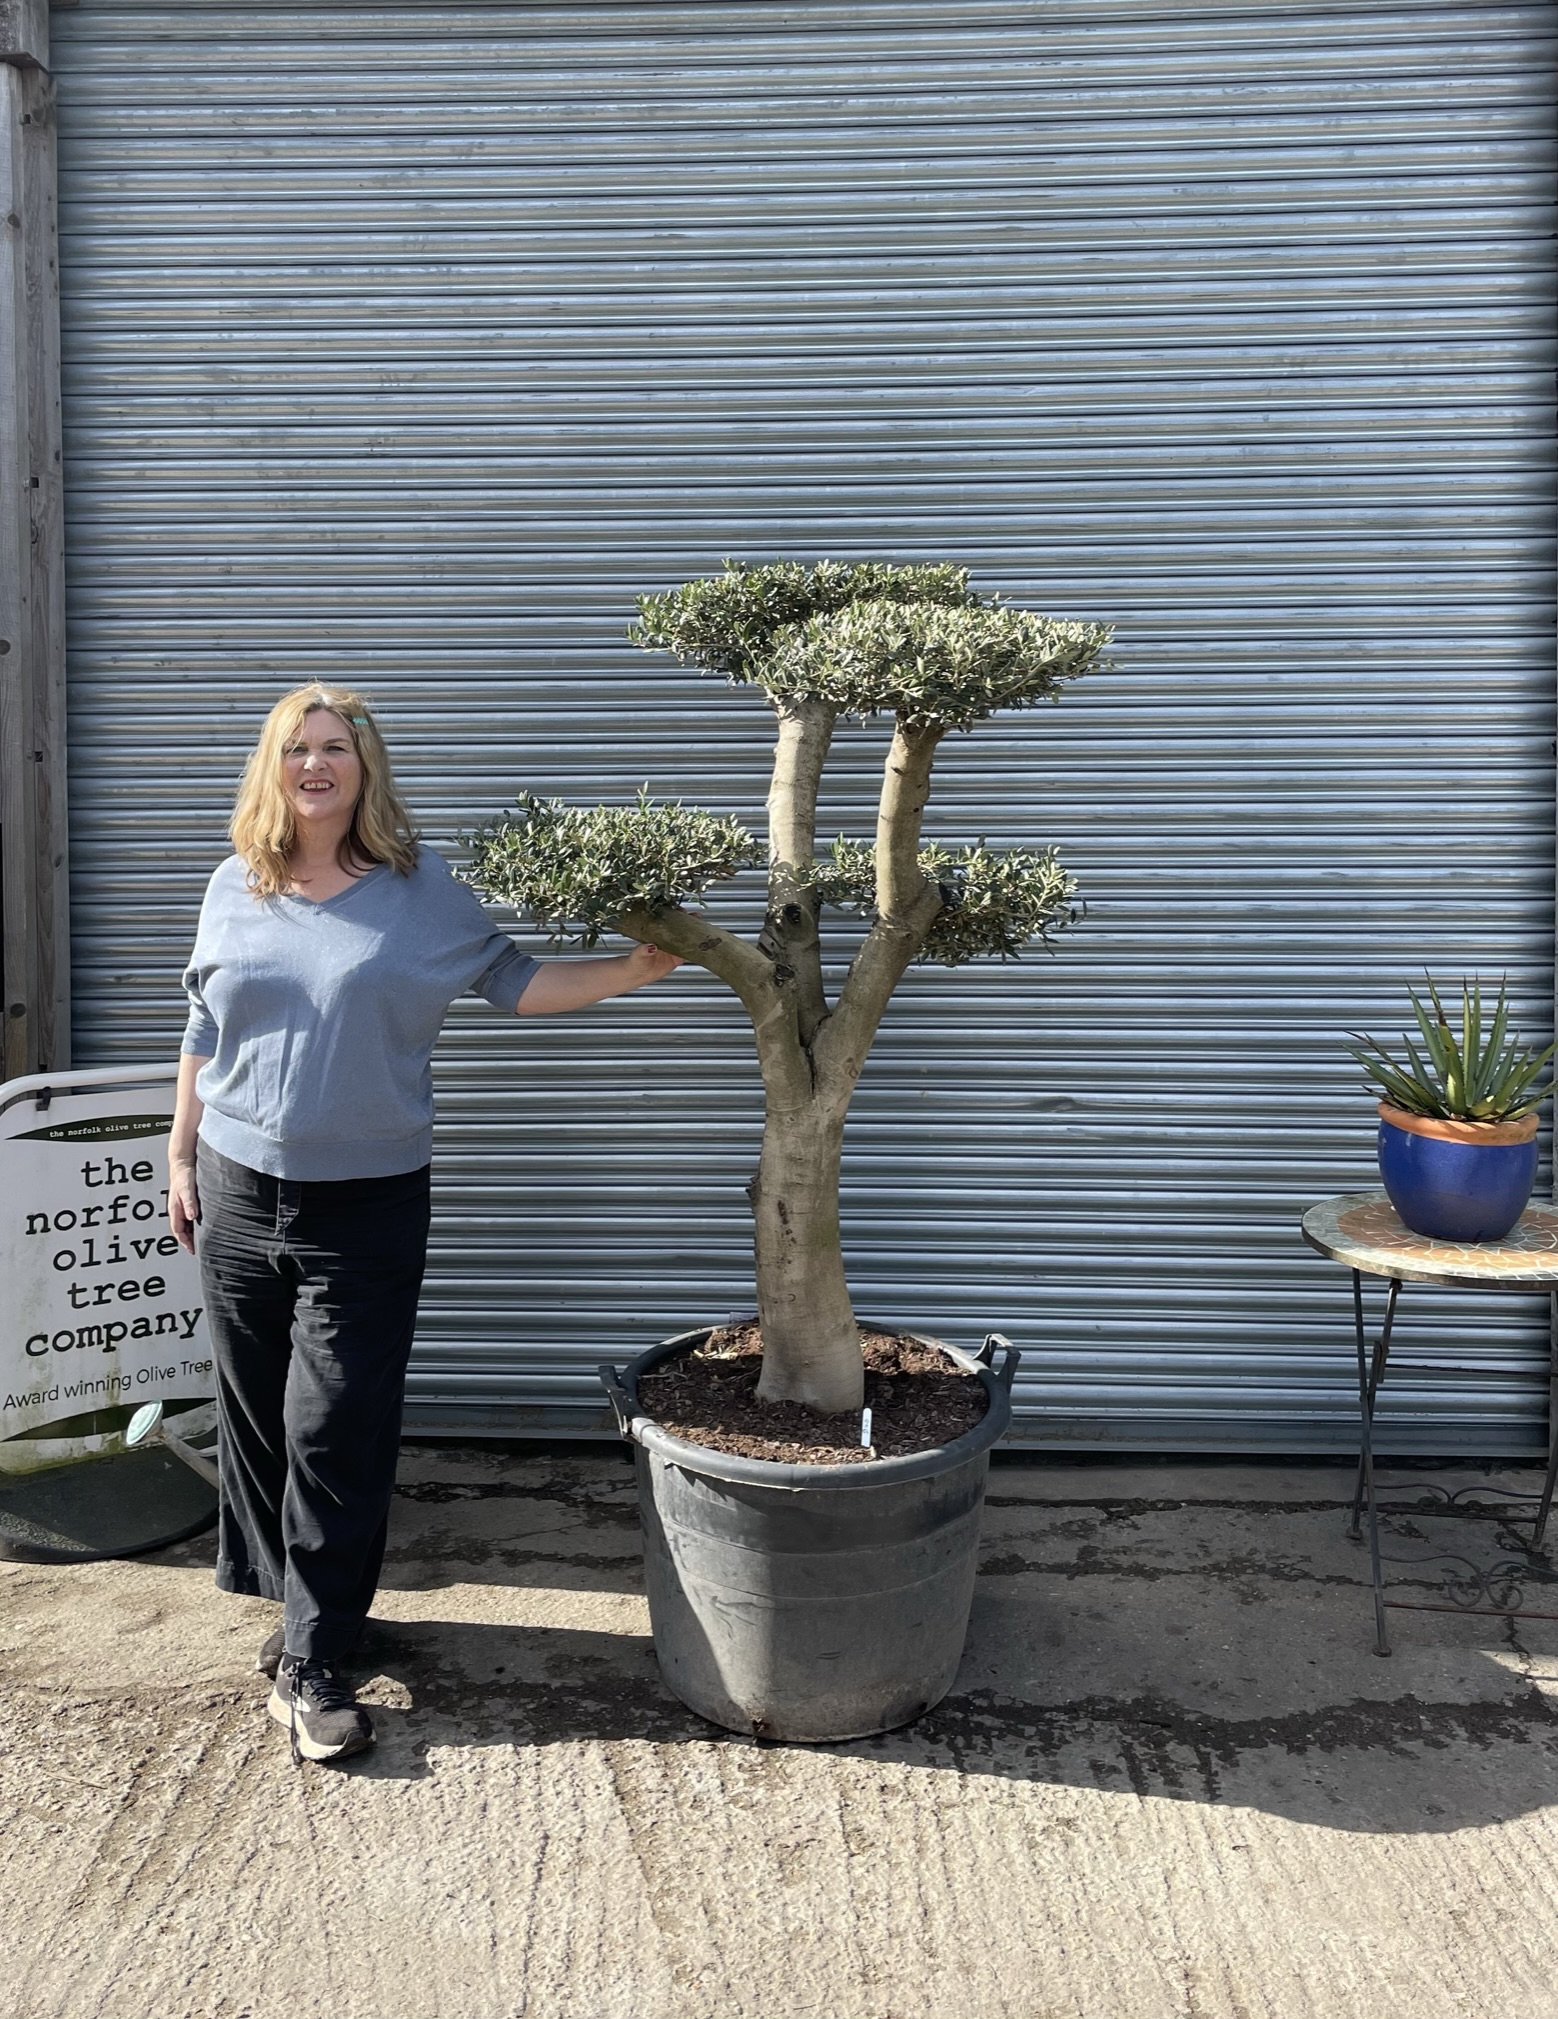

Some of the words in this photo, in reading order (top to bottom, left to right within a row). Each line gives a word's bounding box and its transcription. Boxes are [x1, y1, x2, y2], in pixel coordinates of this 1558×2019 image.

[49, 1130, 65, 1138] the
[68, 1126, 102, 1136] norfolk
[105, 1124, 129, 1132] olive
[133, 1122, 152, 1130] tree
[81, 1157, 154, 1188] the
[25, 1189, 170, 1235] norfol
[53, 1234, 179, 1271] olive
[67, 1275, 166, 1310] tree
[25, 1307, 204, 1357] company
[2, 1384, 60, 1411] Award
[63, 1373, 132, 1397] winning
[136, 1366, 176, 1384] Olive
[180, 1359, 214, 1376] Tree
